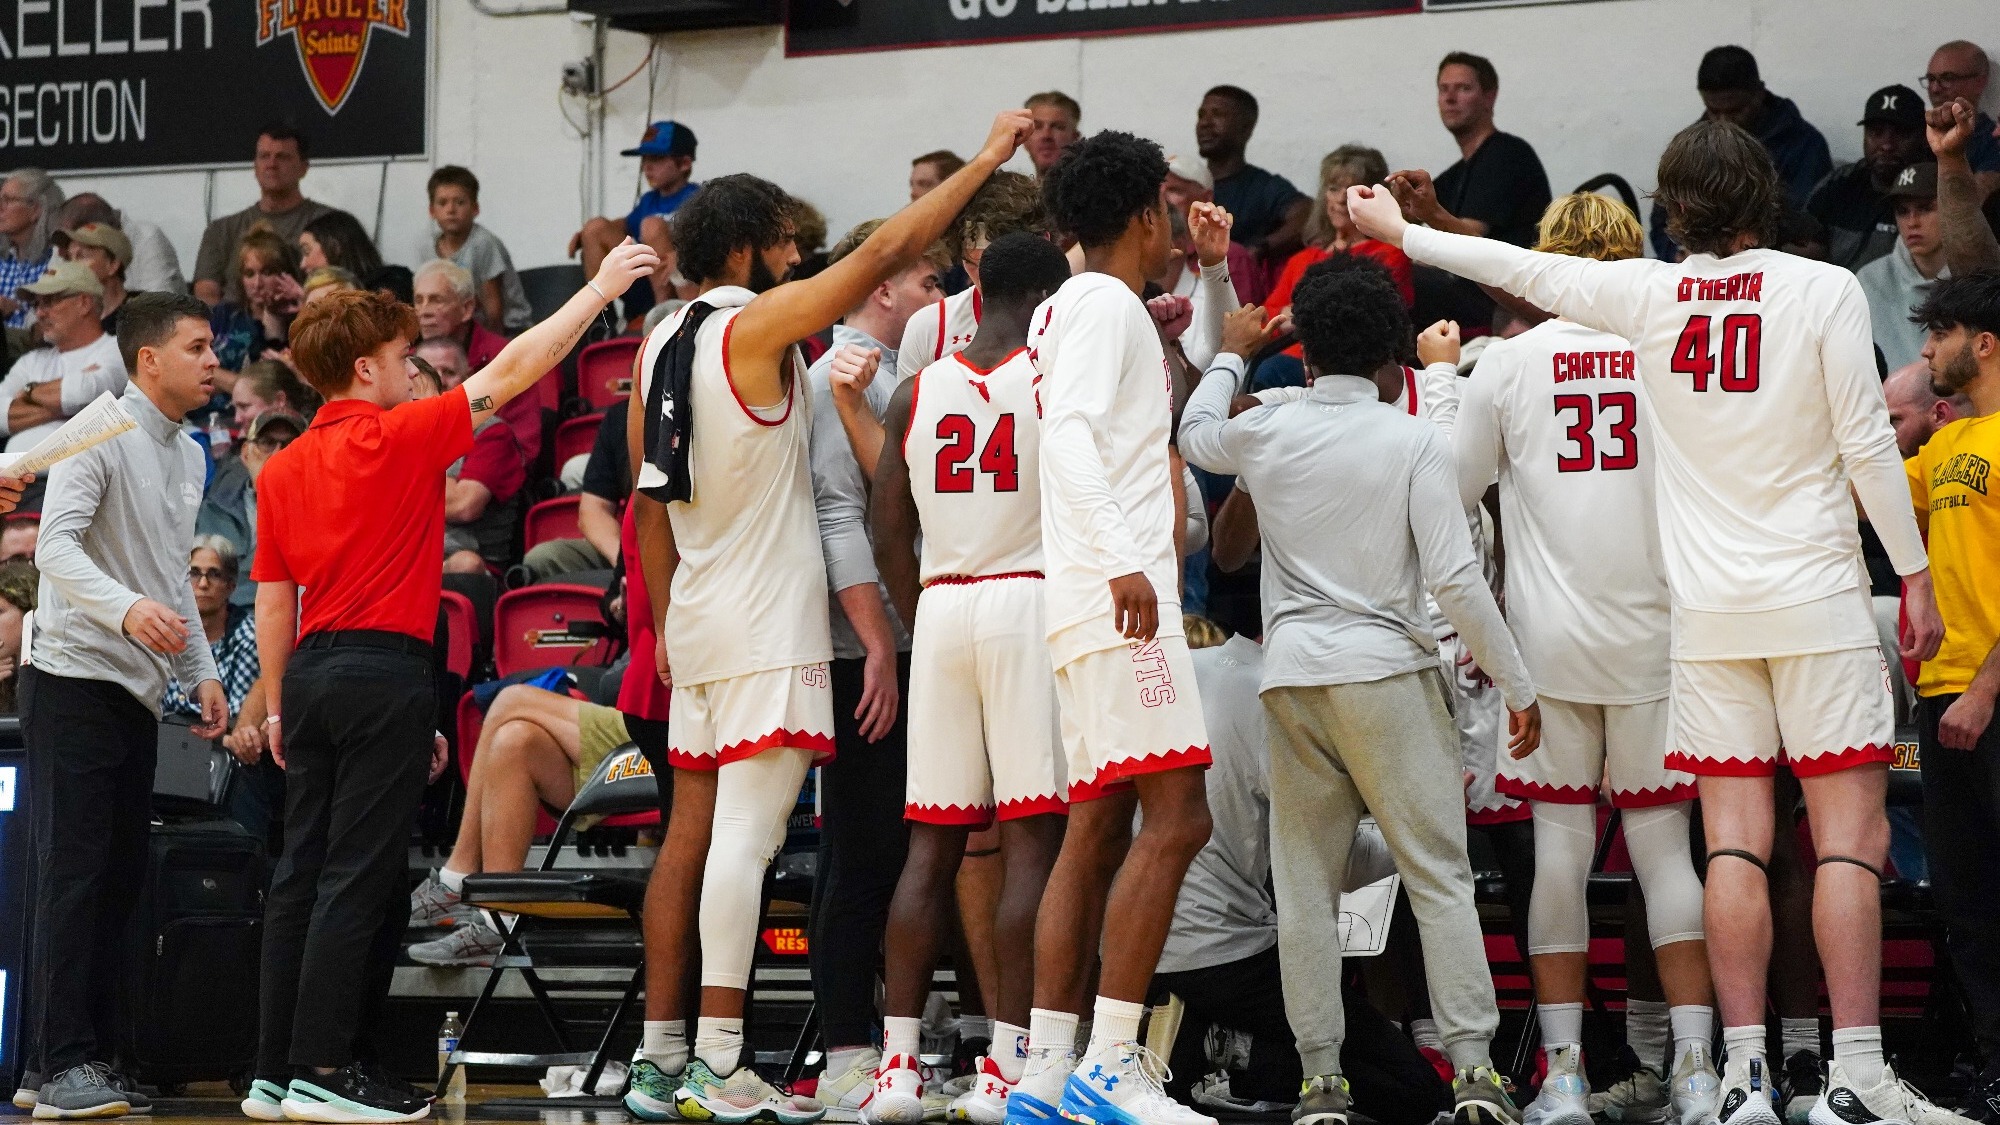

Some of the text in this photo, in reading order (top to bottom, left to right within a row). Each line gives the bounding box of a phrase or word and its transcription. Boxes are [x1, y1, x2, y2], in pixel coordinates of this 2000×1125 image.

[0, 0, 213, 59] ELLER
[306, 30, 360, 55] Saints
[1553, 350, 1635, 384] CARTER
[1671, 314, 1762, 393] 40
[935, 413, 1018, 493] 24
[1554, 391, 1638, 473] 33
[1932, 452, 1990, 496] LAGLER
[1129, 637, 1176, 708] NTS
[605, 753, 655, 783] FLA
[775, 936, 806, 951] RES
